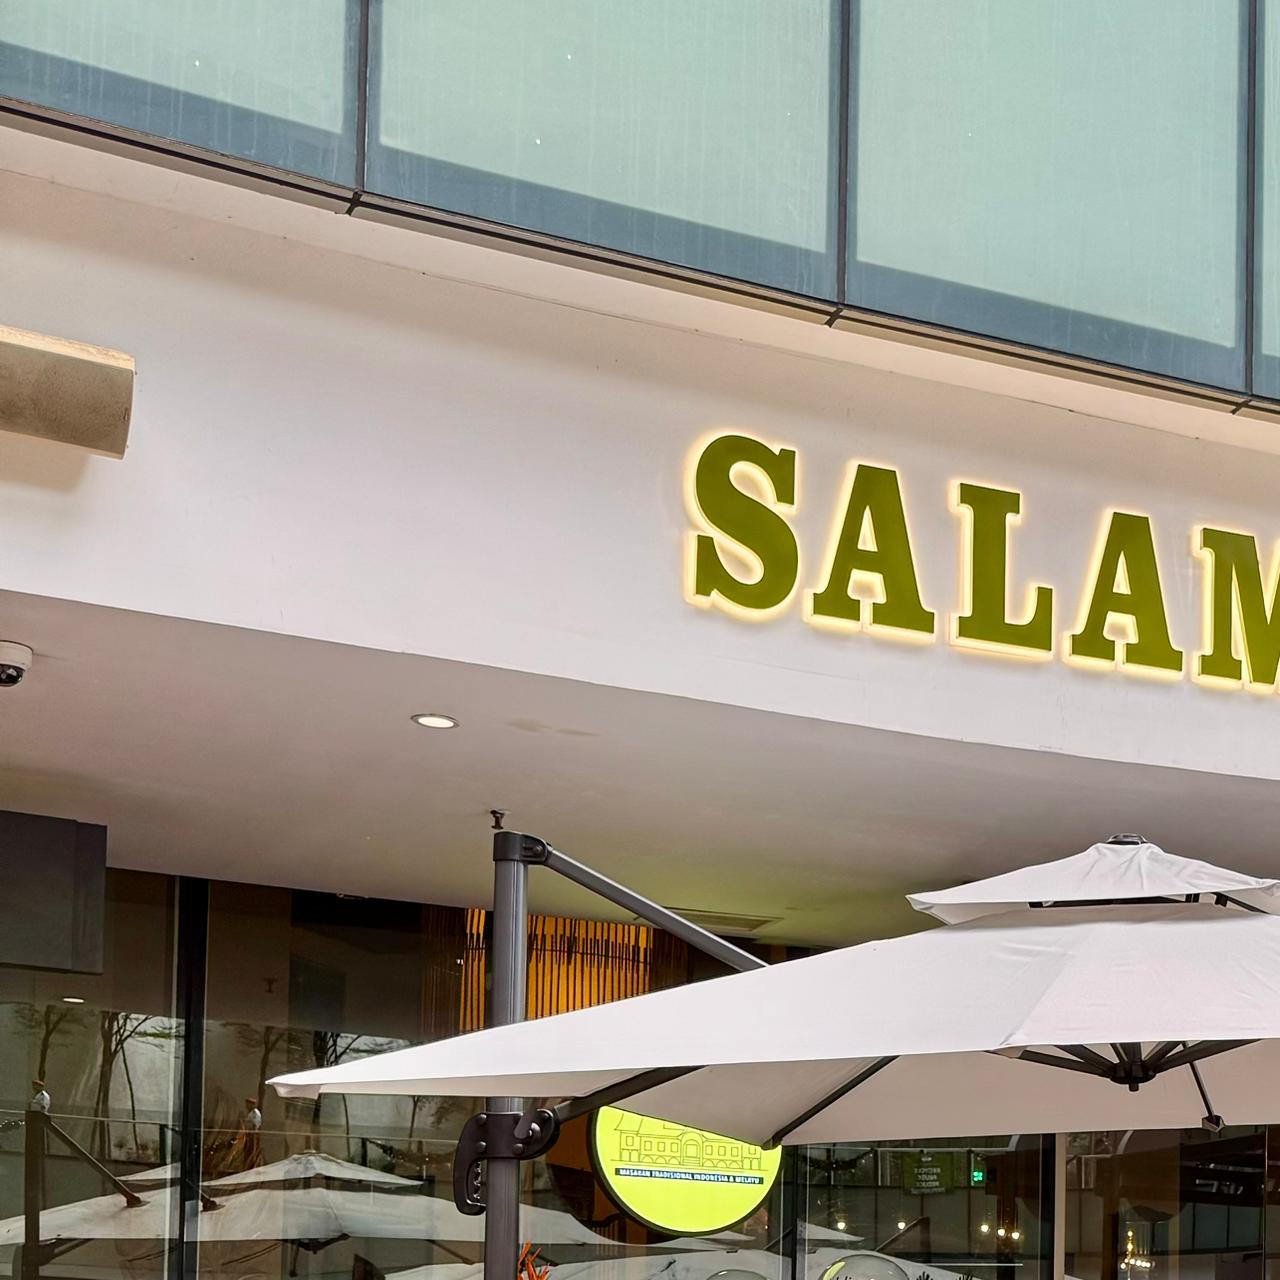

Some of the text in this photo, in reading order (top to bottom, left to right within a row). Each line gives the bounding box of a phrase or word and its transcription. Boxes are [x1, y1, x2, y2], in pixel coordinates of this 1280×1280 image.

[619, 1168, 651, 1177] MASAKAN
[652, 1170, 693, 1180] TRADISIONAL
[693, 1174, 728, 1182] INDONESIA
[735, 1176, 759, 1184] MELAYU
